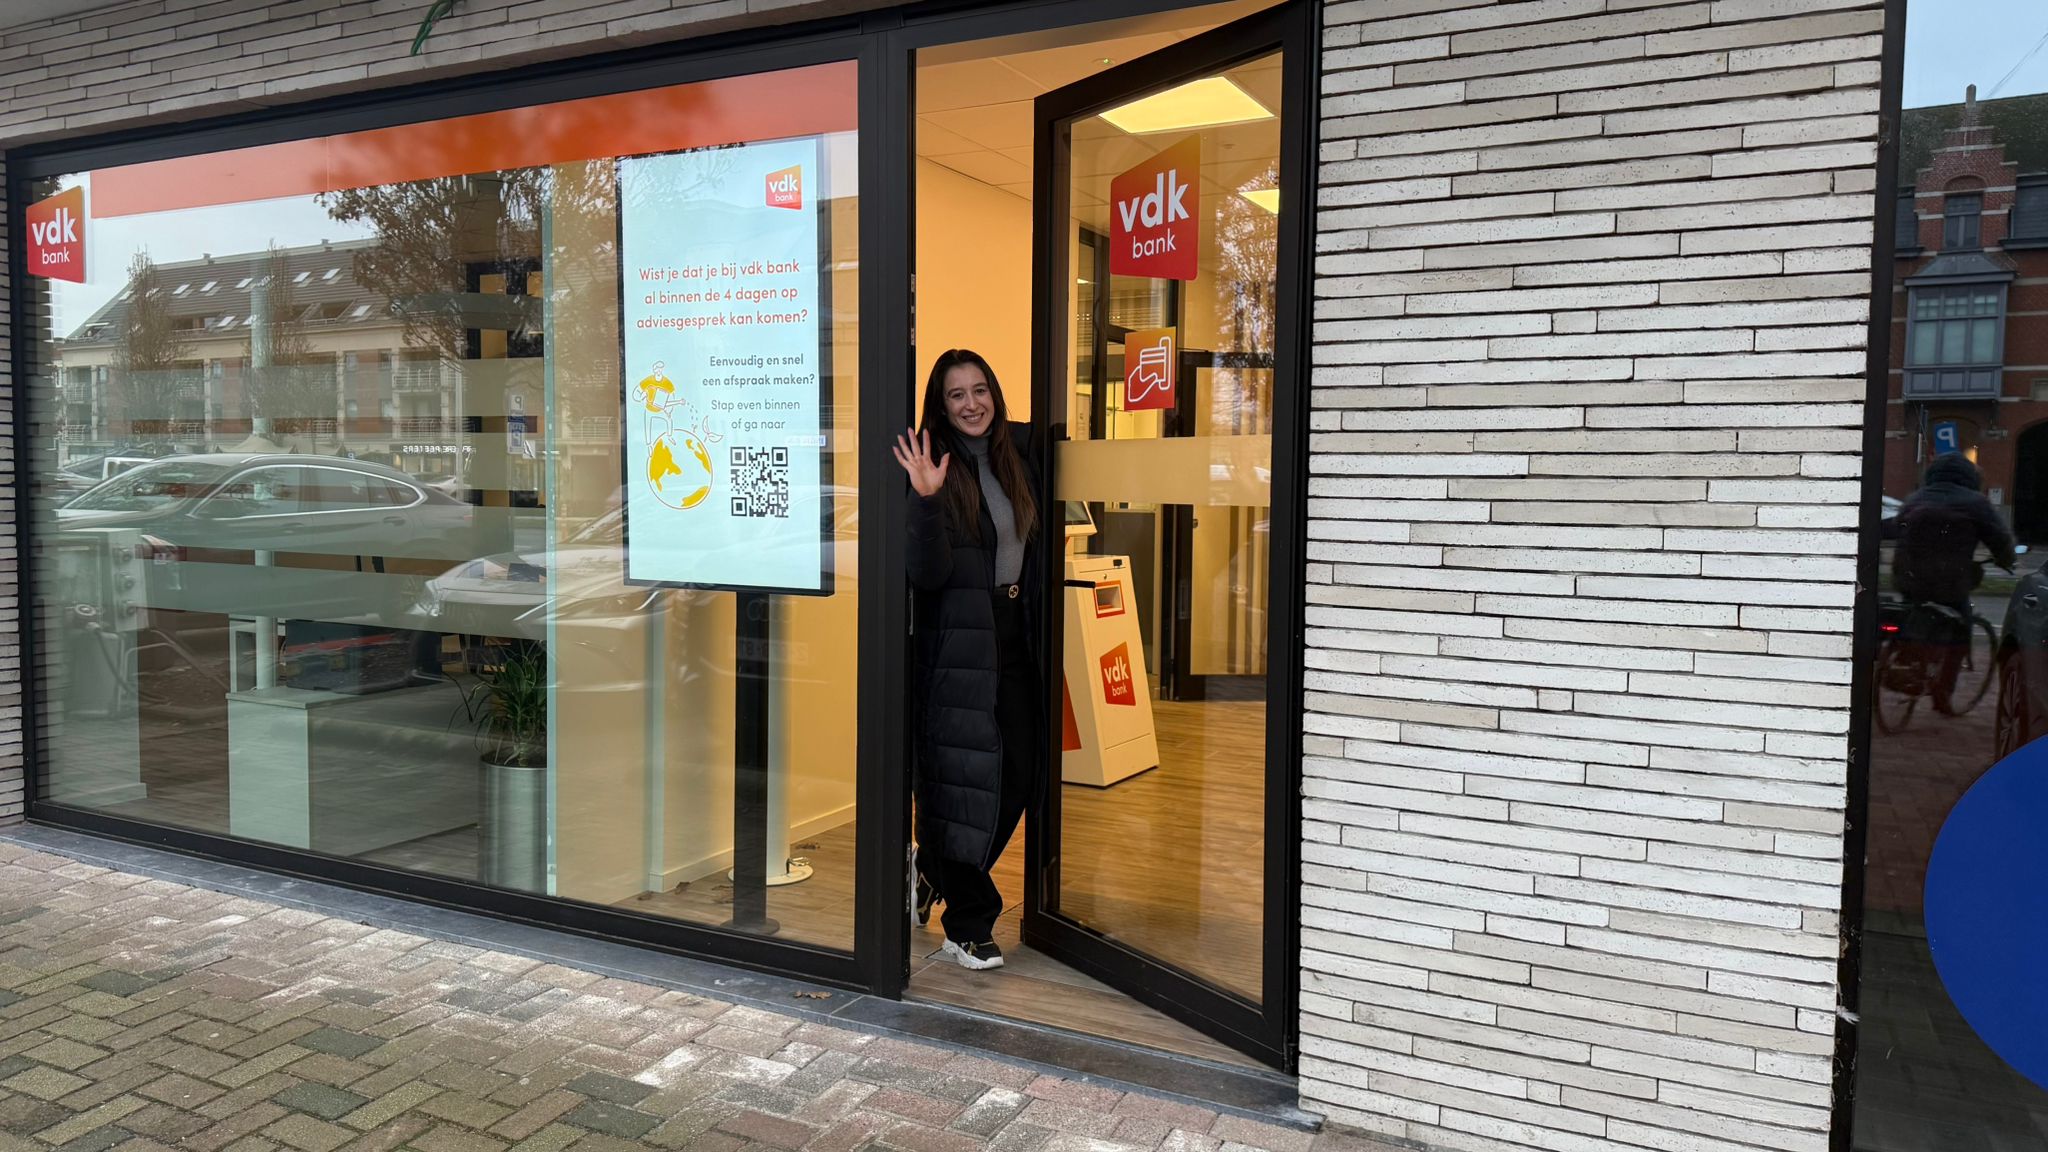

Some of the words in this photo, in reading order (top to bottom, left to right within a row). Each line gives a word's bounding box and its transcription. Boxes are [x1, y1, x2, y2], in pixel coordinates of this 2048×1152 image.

[768, 174, 799, 193] vdk
[775, 192, 794, 202] bank
[1118, 169, 1190, 233] vdk
[31, 207, 78, 246] vdk
[1132, 228, 1177, 259] bank
[41, 246, 70, 265] bank
[639, 267, 665, 281] Wist
[667, 266, 679, 283] je
[682, 265, 703, 279] dat
[705, 264, 717, 281] je
[721, 263, 737, 280] bij
[740, 261, 763, 275] vdk
[766, 259, 800, 274] bank
[644, 291, 656, 304] al
[659, 290, 701, 304] binnen
[704, 289, 720, 302] de
[724, 288, 732, 301] 4
[735, 287, 777, 304] dagen
[781, 288, 798, 303] op
[636, 312, 726, 331] adviesgesprek
[729, 312, 753, 326] kan
[756, 309, 808, 325] komen?
[710, 354, 764, 369] Eenvoudig
[766, 356, 780, 366] en
[782, 353, 804, 365] snel
[702, 377, 721, 386] een
[723, 374, 771, 388] afspraak
[773, 373, 815, 385] maken?
[711, 399, 735, 413] Stap
[737, 401, 762, 410] even
[764, 399, 801, 410] binnen
[731, 418, 742, 429] of
[744, 420, 758, 432] ga
[760, 420, 786, 429] naar
[1103, 656, 1130, 685] vdk
[1111, 683, 1128, 697] bank
